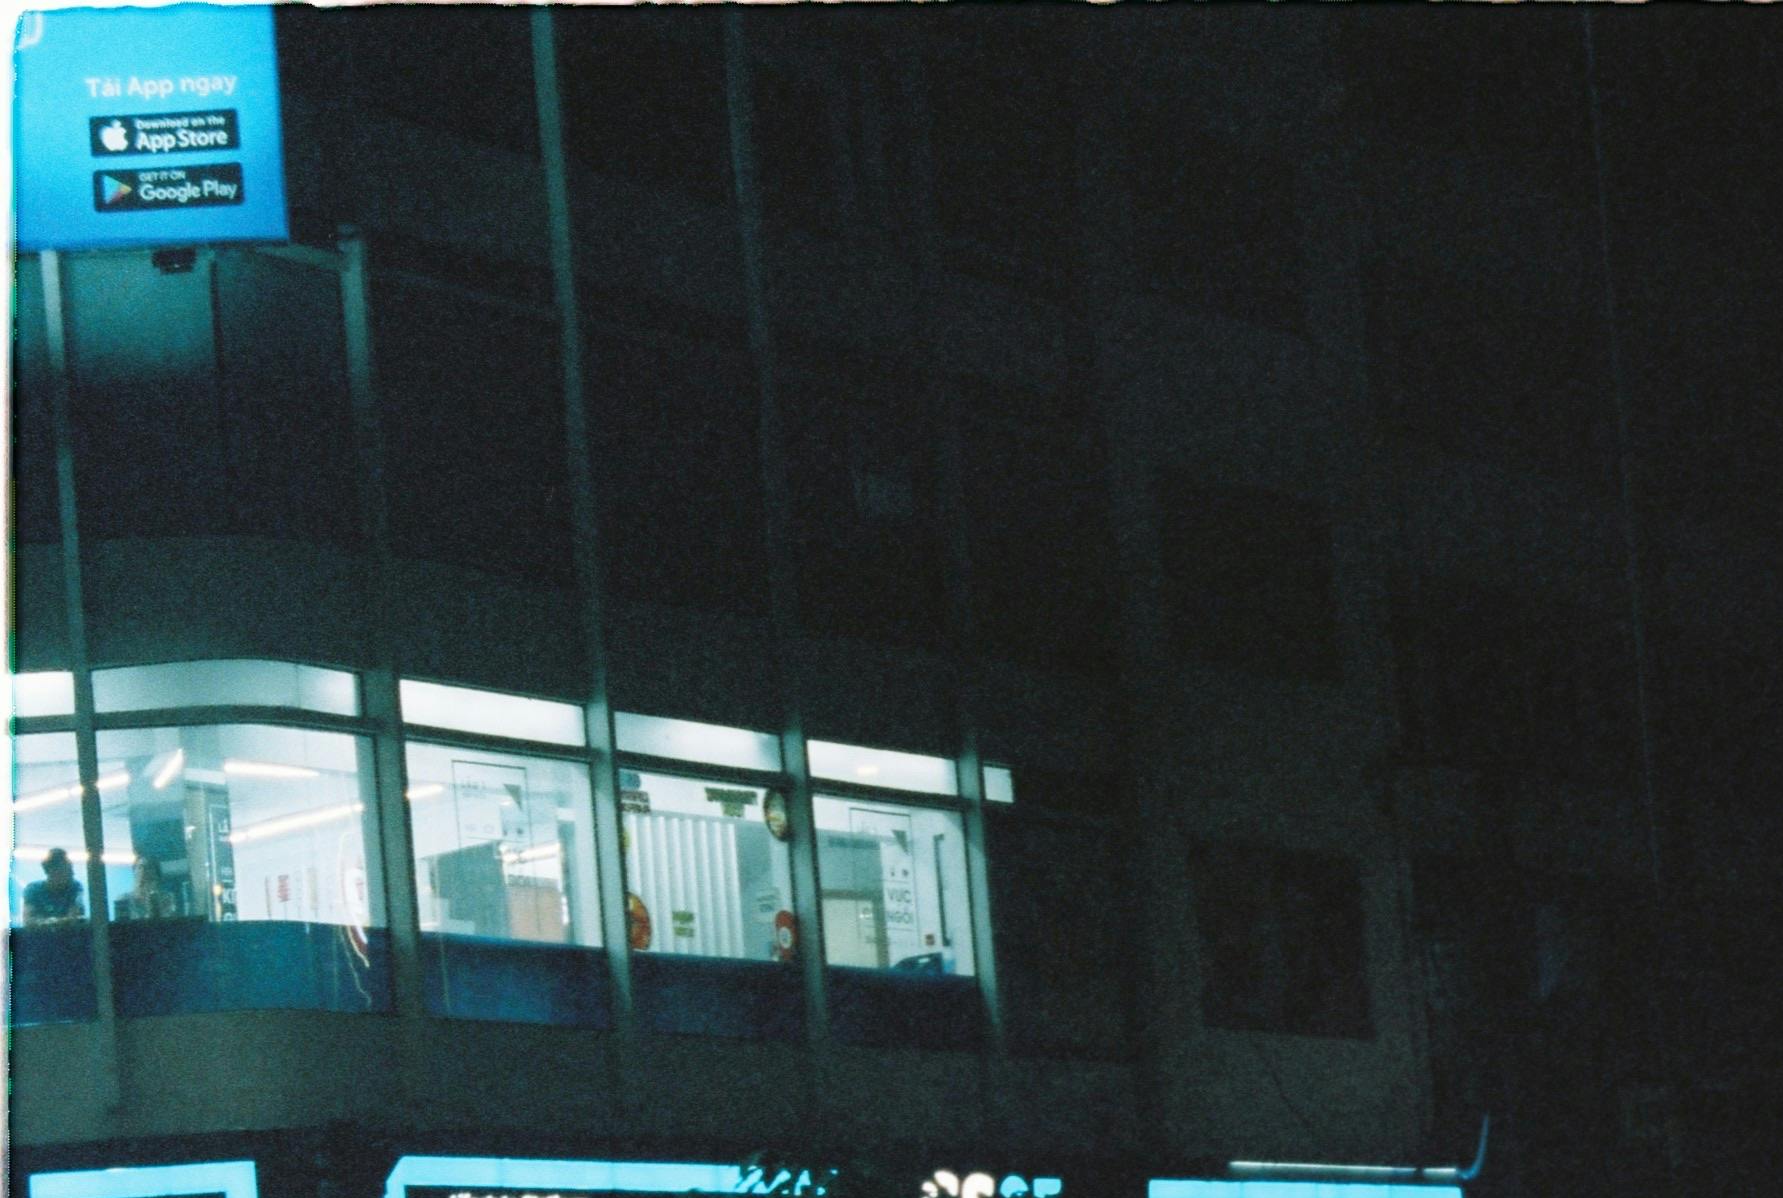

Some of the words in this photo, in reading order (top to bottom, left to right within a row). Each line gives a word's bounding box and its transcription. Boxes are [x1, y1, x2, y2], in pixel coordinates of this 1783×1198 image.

[128, 75, 174, 99] App
[180, 75, 237, 96] ngay
[136, 117, 188, 129] Download
[191, 118, 205, 126] on
[207, 116, 225, 126] the
[137, 132, 176, 153] App
[177, 129, 228, 147] Store
[138, 171, 158, 182] GET
[158, 171, 168, 181] IT
[169, 170, 186, 181] ON
[139, 183, 200, 203] Google
[202, 180, 237, 199] Play
